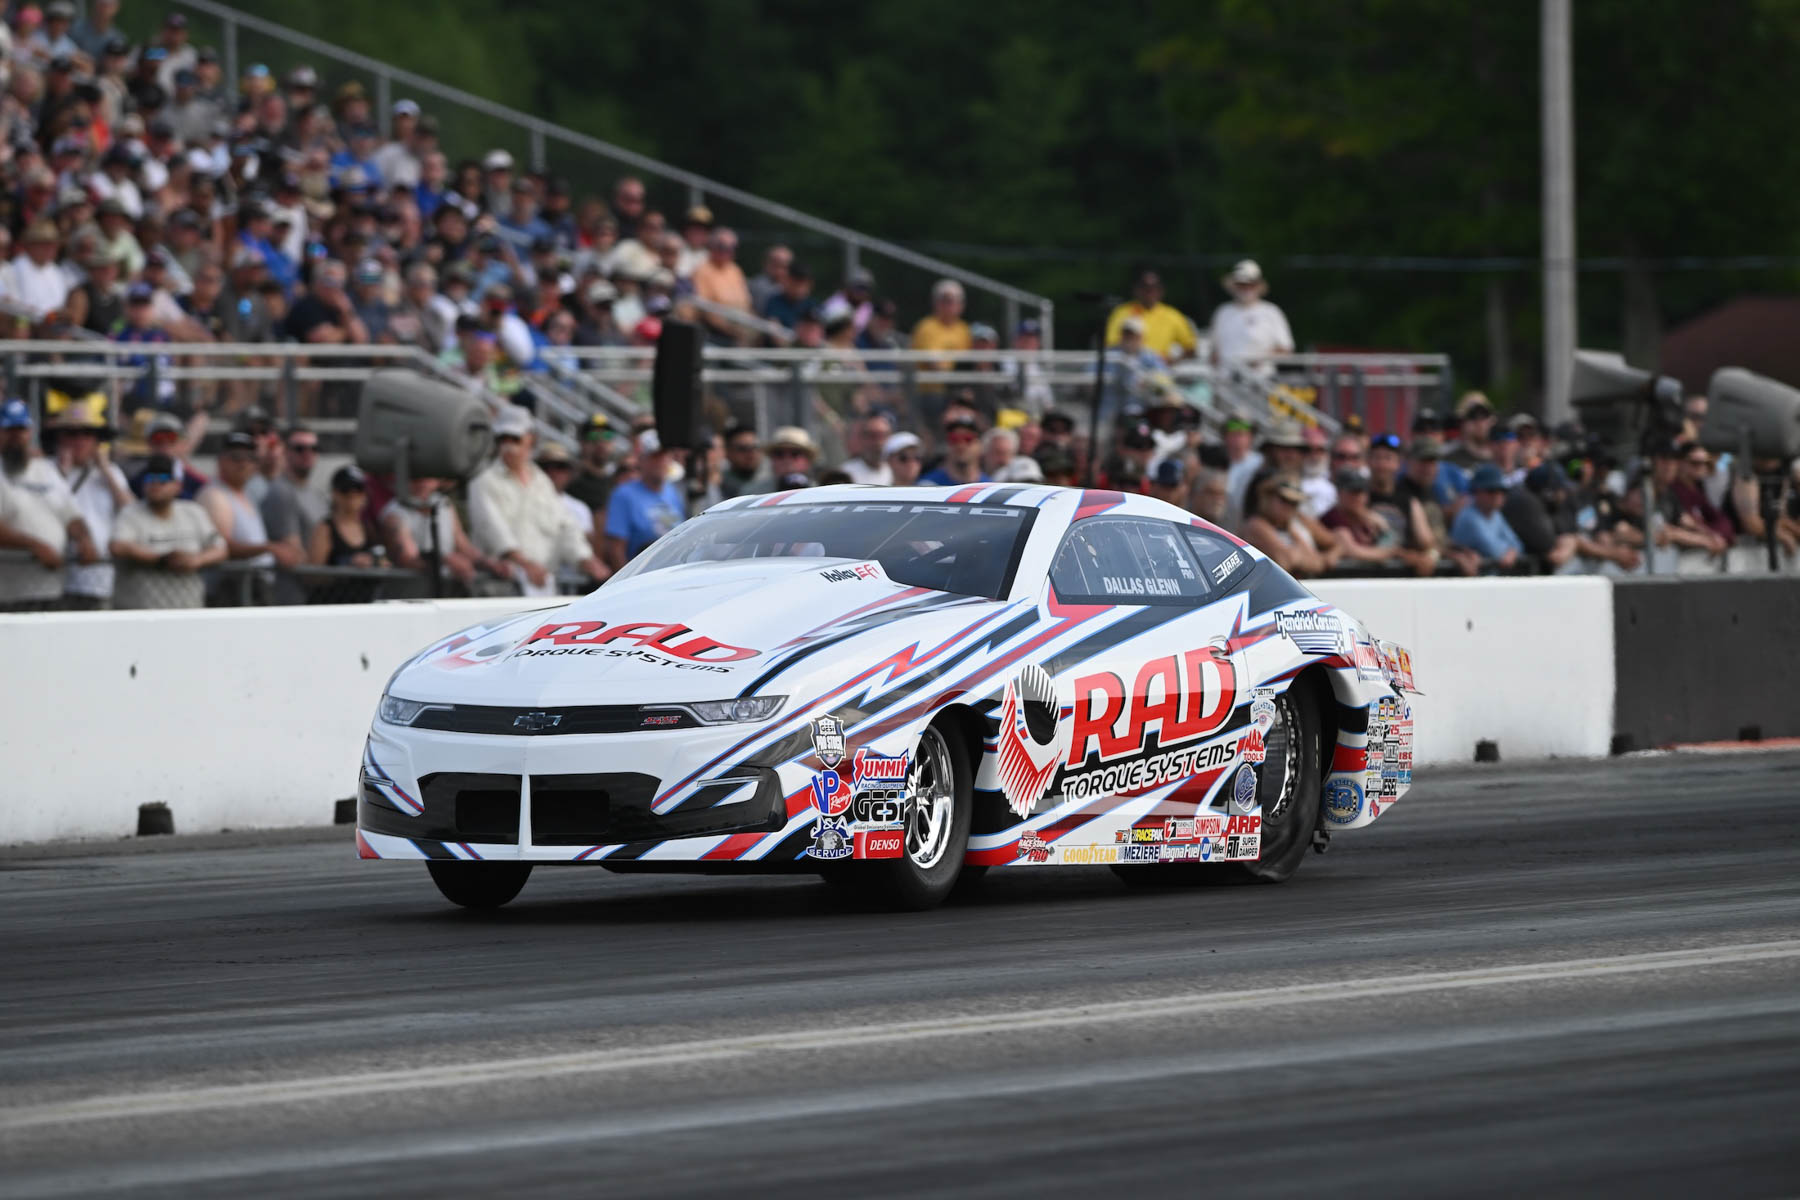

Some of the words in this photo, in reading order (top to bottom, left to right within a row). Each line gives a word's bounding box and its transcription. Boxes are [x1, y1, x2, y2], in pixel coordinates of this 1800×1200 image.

[819, 568, 862, 583] Holley
[855, 564, 880, 579] EFI
[1180, 569, 1196, 580] PRO
[1103, 577, 1144, 595] DALLAS
[1145, 578, 1181, 595] GLENN
[1274, 611, 1314, 638] Hendrick
[522, 621, 763, 663] RAD
[604, 648, 735, 674] SYSTEMS
[1066, 645, 1237, 767] RAD
[1244, 728, 1264, 752] MAC
[1243, 753, 1264, 761] TOOLS
[1062, 760, 1146, 803] TORQUE
[1145, 740, 1237, 782] SYSTEMS
[811, 770, 840, 814] VP
[830, 792, 852, 810] Racing
[853, 790, 905, 822] GESI
[810, 815, 848, 838] J&A
[1195, 818, 1221, 835] SIMPSON
[1227, 816, 1260, 834] ARP
[1136, 828, 1164, 841] RACEPAK
[1242, 837, 1257, 846] SUPER
[808, 847, 853, 858] SERVICE
[869, 839, 900, 851] DENSO
[1124, 846, 1159, 860] MEZIERE
[1160, 845, 1200, 862] MagnaFuel
[1226, 836, 1239, 858] ATI
[1239, 847, 1258, 857] DAMPER
[1028, 849, 1049, 862] PRO
